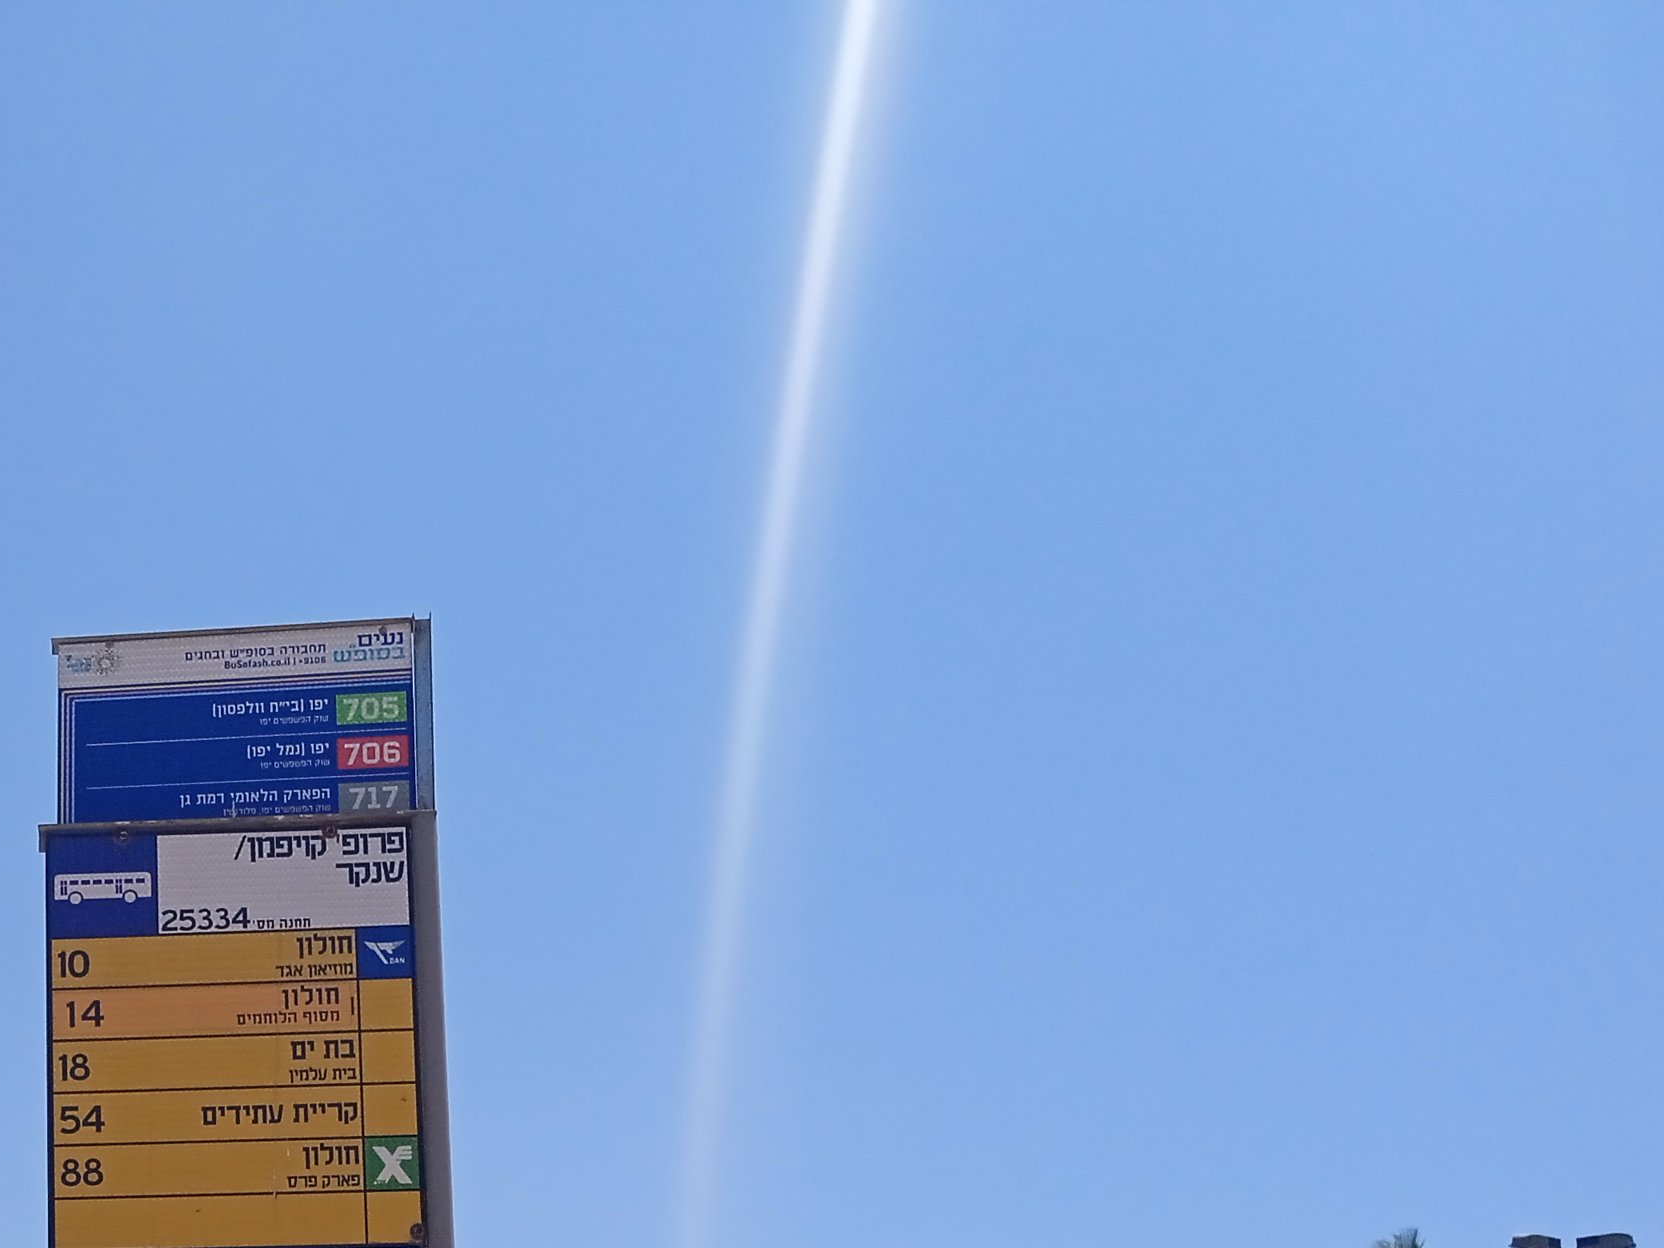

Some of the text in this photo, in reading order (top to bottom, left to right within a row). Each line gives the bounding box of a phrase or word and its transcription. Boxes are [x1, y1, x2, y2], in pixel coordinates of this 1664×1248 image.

[280, 643, 326, 655] תחבורה
[357, 632, 404, 647] נעים
[185, 650, 225, 663] ובחגים
[309, 699, 329, 716] יפו
[343, 696, 399, 722] 705
[310, 743, 330, 757] יפו
[344, 740, 401, 766] 706
[180, 787, 331, 808] הפארק הלאומי רמת גן
[349, 785, 398, 810] 717
[337, 831, 405, 855] פרופ'
[336, 861, 405, 888] שנקר
[161, 907, 251, 932] 25334
[280, 918, 311, 929] תחנה
[296, 933, 353, 959] חולון
[57, 950, 91, 978] 10
[275, 962, 354, 978] מוזיאון אגד
[282, 985, 339, 1010] חולון
[66, 999, 105, 1028] 14
[237, 1010, 340, 1026] מסוף הלוחמים
[290, 1039, 356, 1061] בת ים
[58, 1053, 91, 1082] 18
[289, 1067, 357, 1083] בית עלמין
[59, 1104, 105, 1135] 54
[201, 1101, 358, 1126] קריית עתידים
[302, 1143, 360, 1170] חולון
[60, 1158, 105, 1187] 88
[286, 1174, 361, 1189] פארק פרס
